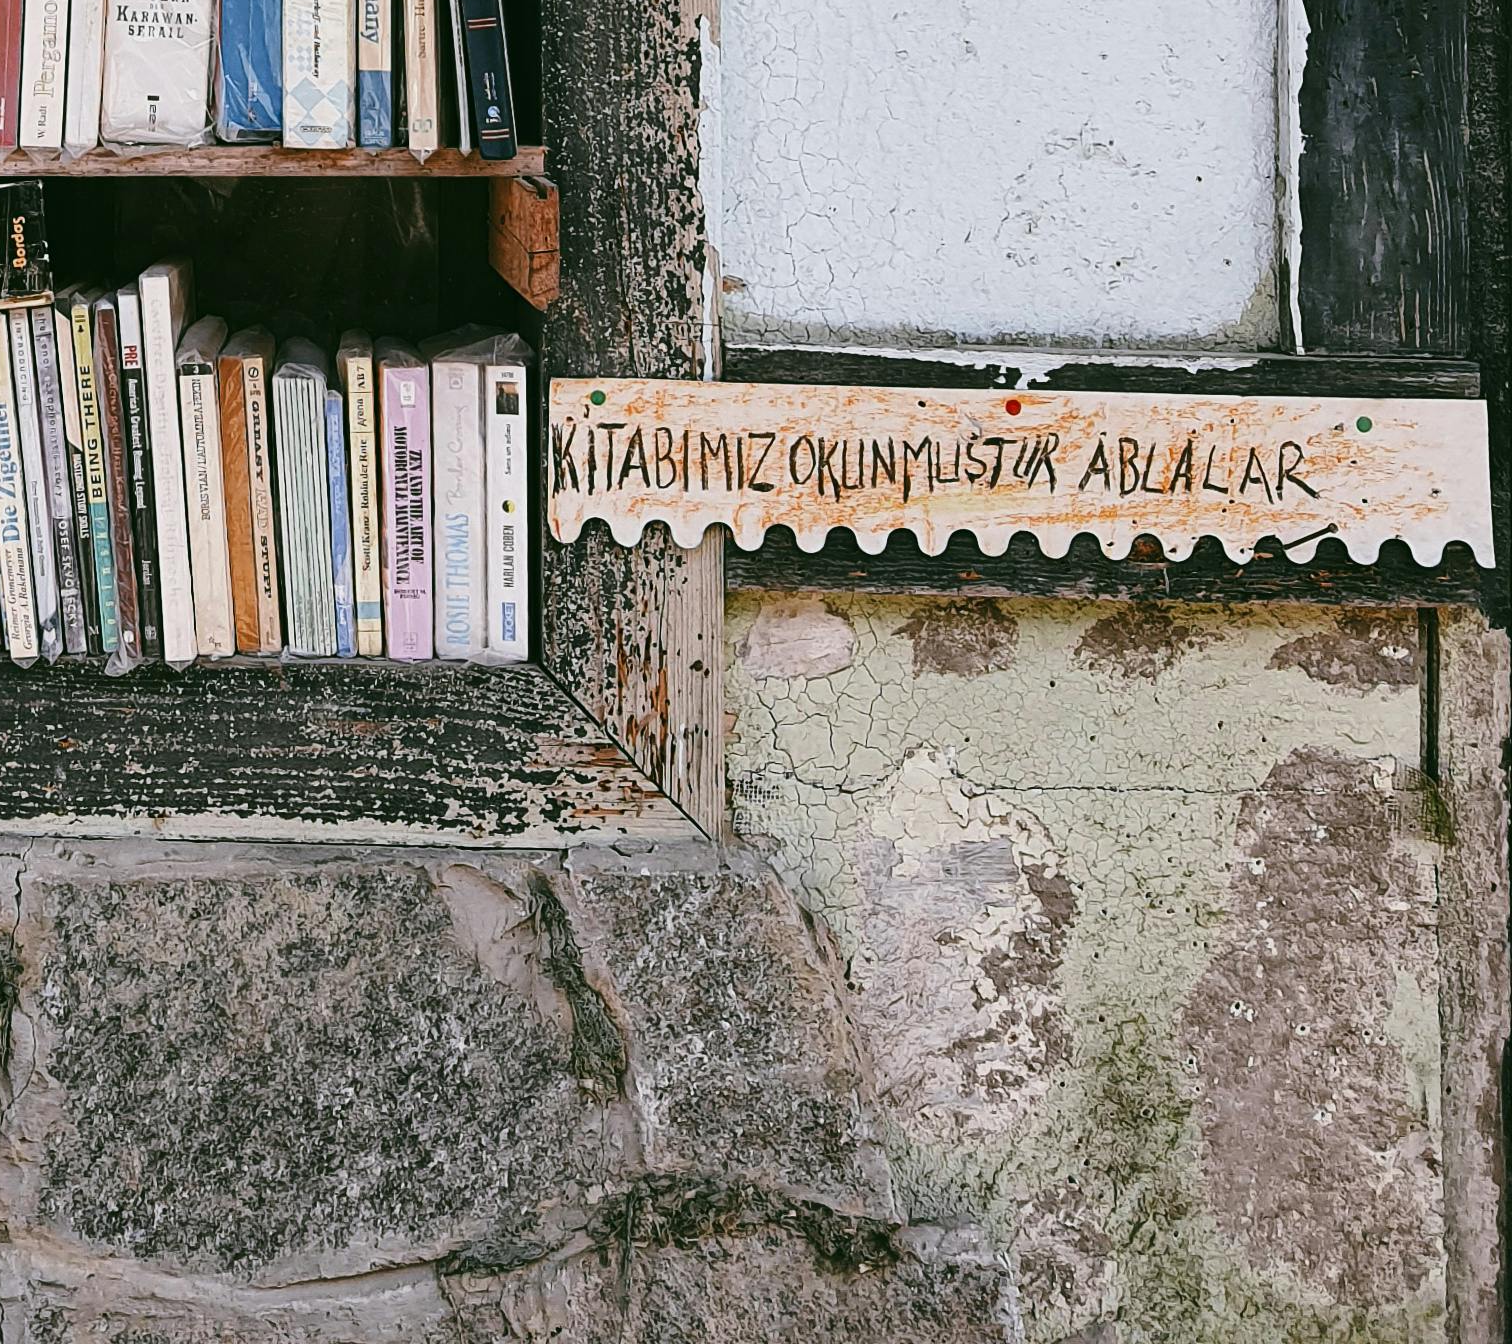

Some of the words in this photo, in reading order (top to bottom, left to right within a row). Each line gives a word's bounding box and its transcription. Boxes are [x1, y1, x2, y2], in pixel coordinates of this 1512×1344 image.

[115, 5, 198, 24] KARAWAN-
[127, 24, 185, 39] SERAIL
[12, 215, 26, 269] Bordas
[122, 344, 138, 368] PRE
[357, 372, 366, 389] AB
[79, 364, 96, 430] THERE
[356, 398, 368, 428] Arena
[251, 400, 265, 483] GREASY
[503, 423, 512, 445] adieu
[358, 439, 368, 463] Rote
[393, 425, 408, 502] MOTORCYCLE
[409, 449, 424, 471] ZEN
[551, 405, 777, 496] KİTABIMIZ
[1078, 430, 1321, 504] ABLALAR
[87, 438, 104, 499] BEING
[197, 469, 209, 493] VIAN
[359, 464, 368, 480] der
[503, 458, 512, 476] Sans
[359, 480, 370, 510] Robin
[409, 475, 424, 497] AND
[198, 493, 211, 521] BORIS
[410, 497, 424, 521] THE
[1, 505, 21, 545] Die
[409, 524, 424, 548] ART
[502, 524, 515, 553] COBEN
[395, 503, 410, 585] MAINTENANCE
[409, 548, 425, 565] OF
[445, 512, 470, 590] THOMAS
[15, 547, 29, 600] Rakelmann
[141, 559, 153, 586] Jordan
[502, 555, 515, 588] HARLAN
[20, 613, 34, 650] Georgia
[446, 594, 471, 646] ROSIE
[502, 602, 516, 642] POCKET
